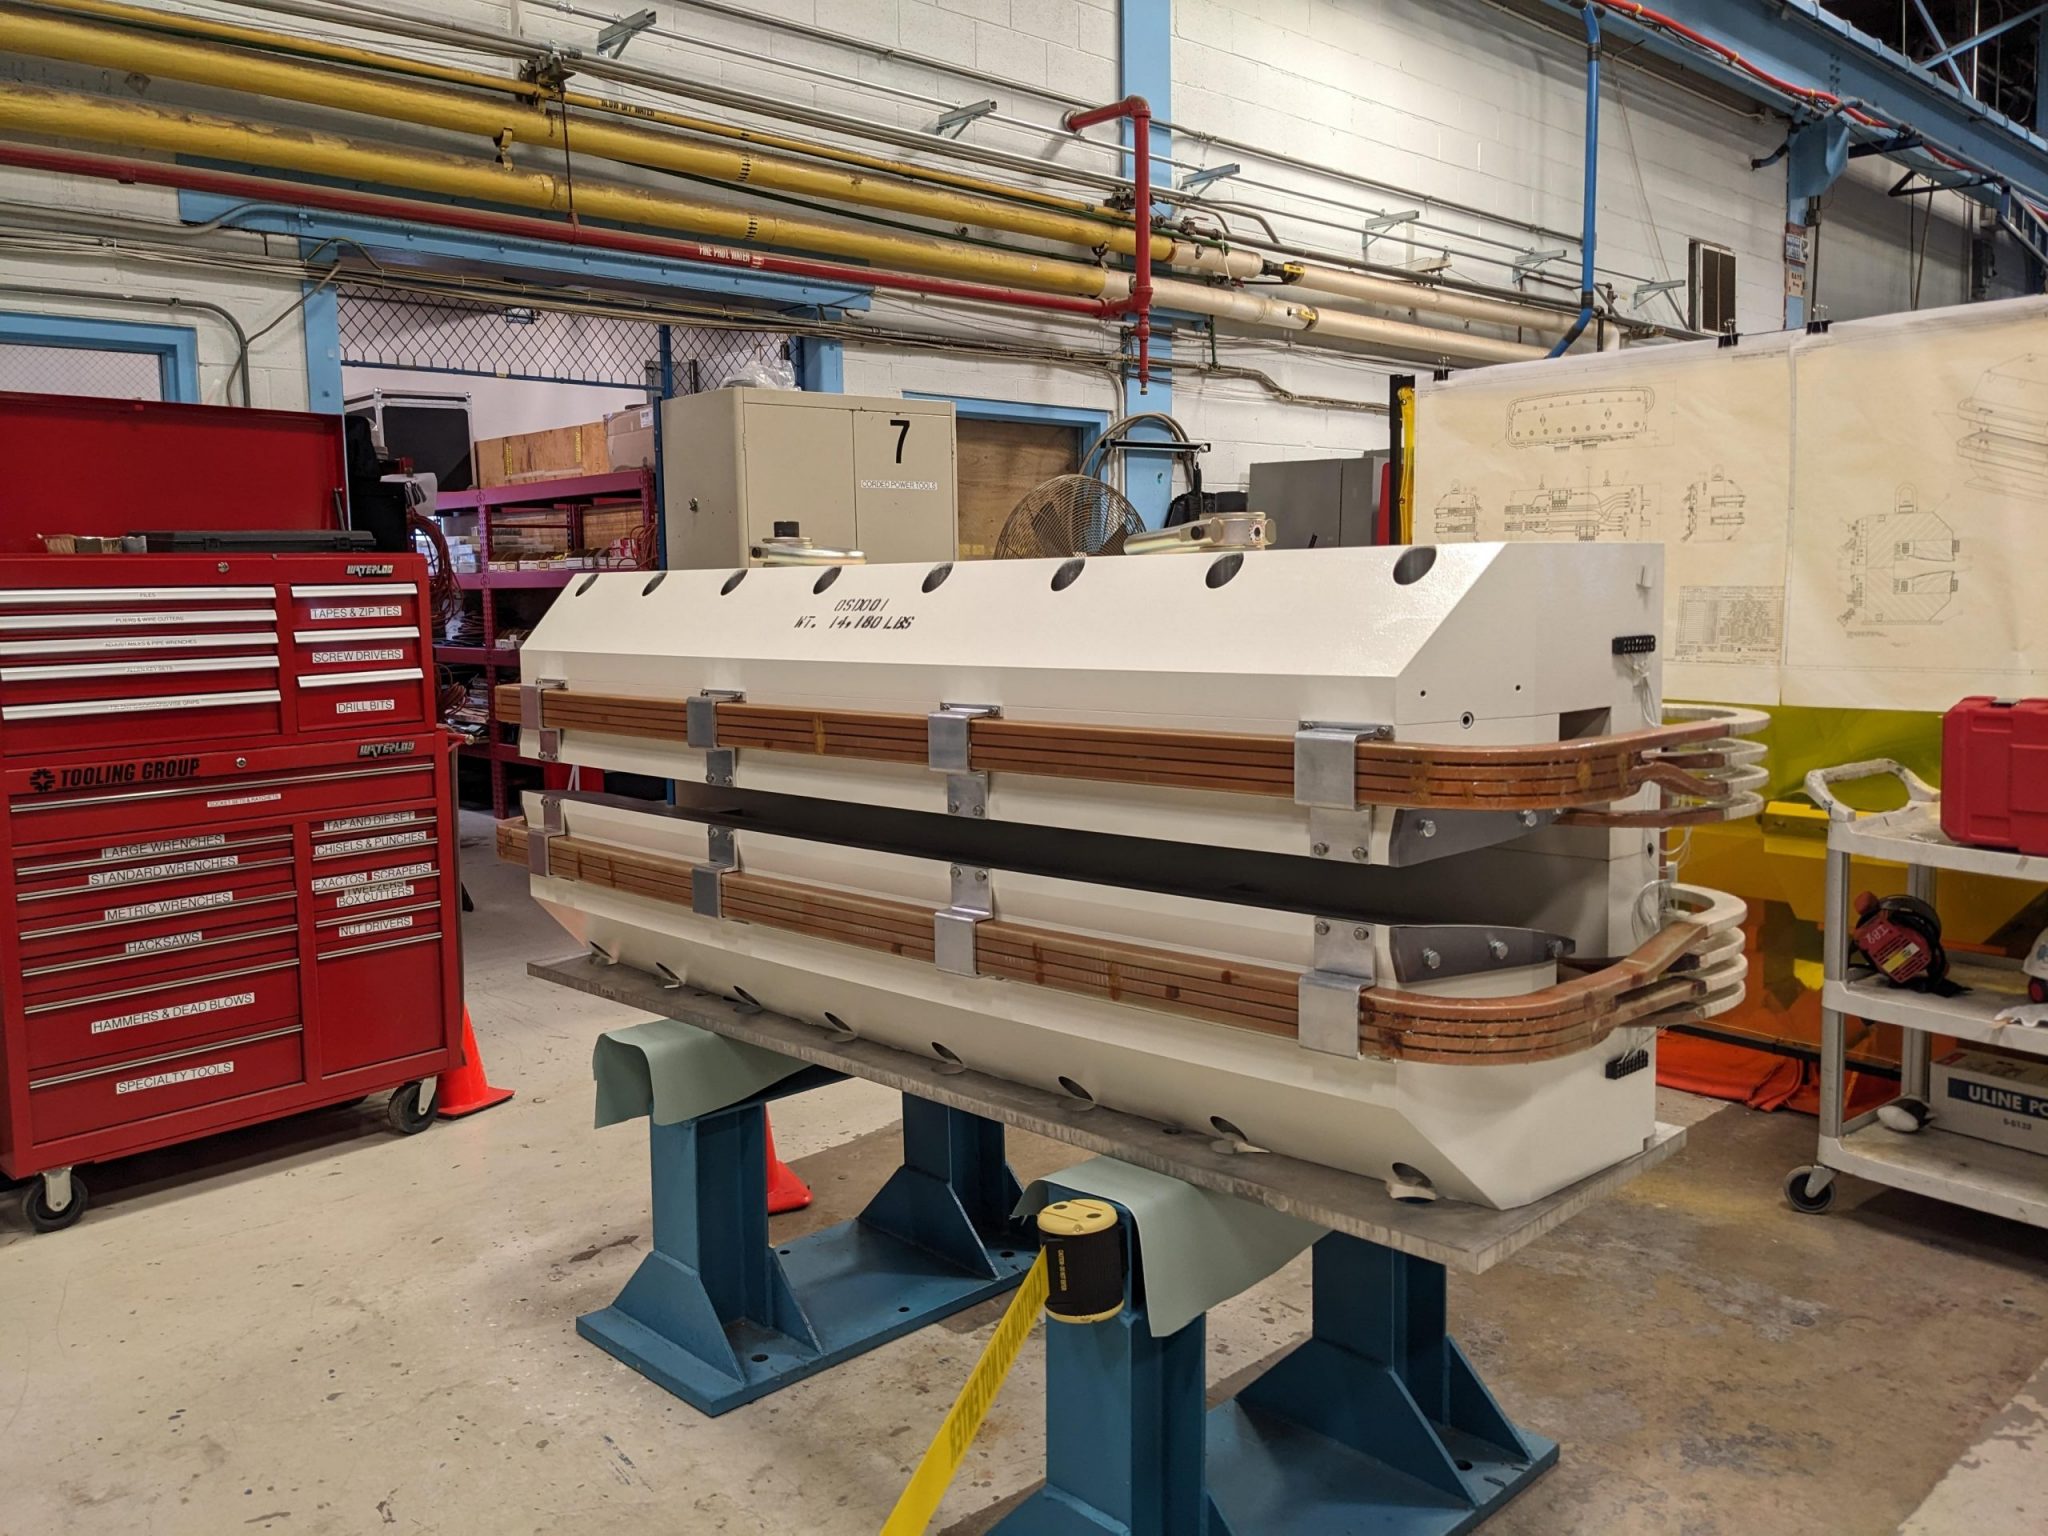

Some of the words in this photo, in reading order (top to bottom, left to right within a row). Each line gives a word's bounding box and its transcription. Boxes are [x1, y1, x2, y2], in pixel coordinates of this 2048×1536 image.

[634, 106, 655, 117] WATER
[889, 419, 911, 464] 7
[862, 480, 890, 488] CORDED
[891, 481, 915, 489] POWER
[915, 481, 936, 490] TOOLS
[346, 564, 394, 576] WATERLOO
[313, 608, 348, 618] TAPES
[349, 608, 357, 617] &
[359, 607, 375, 616] ZIP
[378, 606, 400, 616] TIES
[883, 615, 914, 629] LBS
[314, 652, 354, 663] SCREW
[356, 649, 401, 661] DRIVERS
[338, 702, 368, 712] DRILL
[370, 700, 392, 711] BITS
[60, 763, 136, 787] TOOLING
[141, 757, 201, 780] GROUP
[326, 820, 347, 831] TAP
[349, 817, 372, 828] AND
[104, 846, 148, 859] LARGE
[150, 835, 223, 852] WRENCHES
[316, 842, 364, 855] CHISELS
[365, 840, 372, 848] &
[374, 831, 425, 847] PUNCHES
[91, 866, 162, 885] STANDARD
[165, 857, 236, 874] WRENCHES
[372, 864, 430, 881] SCRAPERS
[313, 874, 366, 890] EXACTOS
[107, 903, 157, 920] METRIC
[159, 892, 231, 912] WRENCHES
[338, 895, 361, 907] BOX
[363, 886, 412, 903] CUTTERS
[340, 925, 364, 936] NUT
[365, 917, 411, 932] DRIVERS
[127, 932, 200, 952] HACKSAWS
[93, 1010, 159, 1032] HAMMERS
[161, 1009, 170, 1018] &
[173, 1002, 207, 1016] DEAD
[209, 993, 253, 1010] BLOWS
[118, 1071, 188, 1092] SPECIALTY
[191, 1062, 232, 1078] TOOLS
[1968, 1084, 2022, 1111] ULINE
